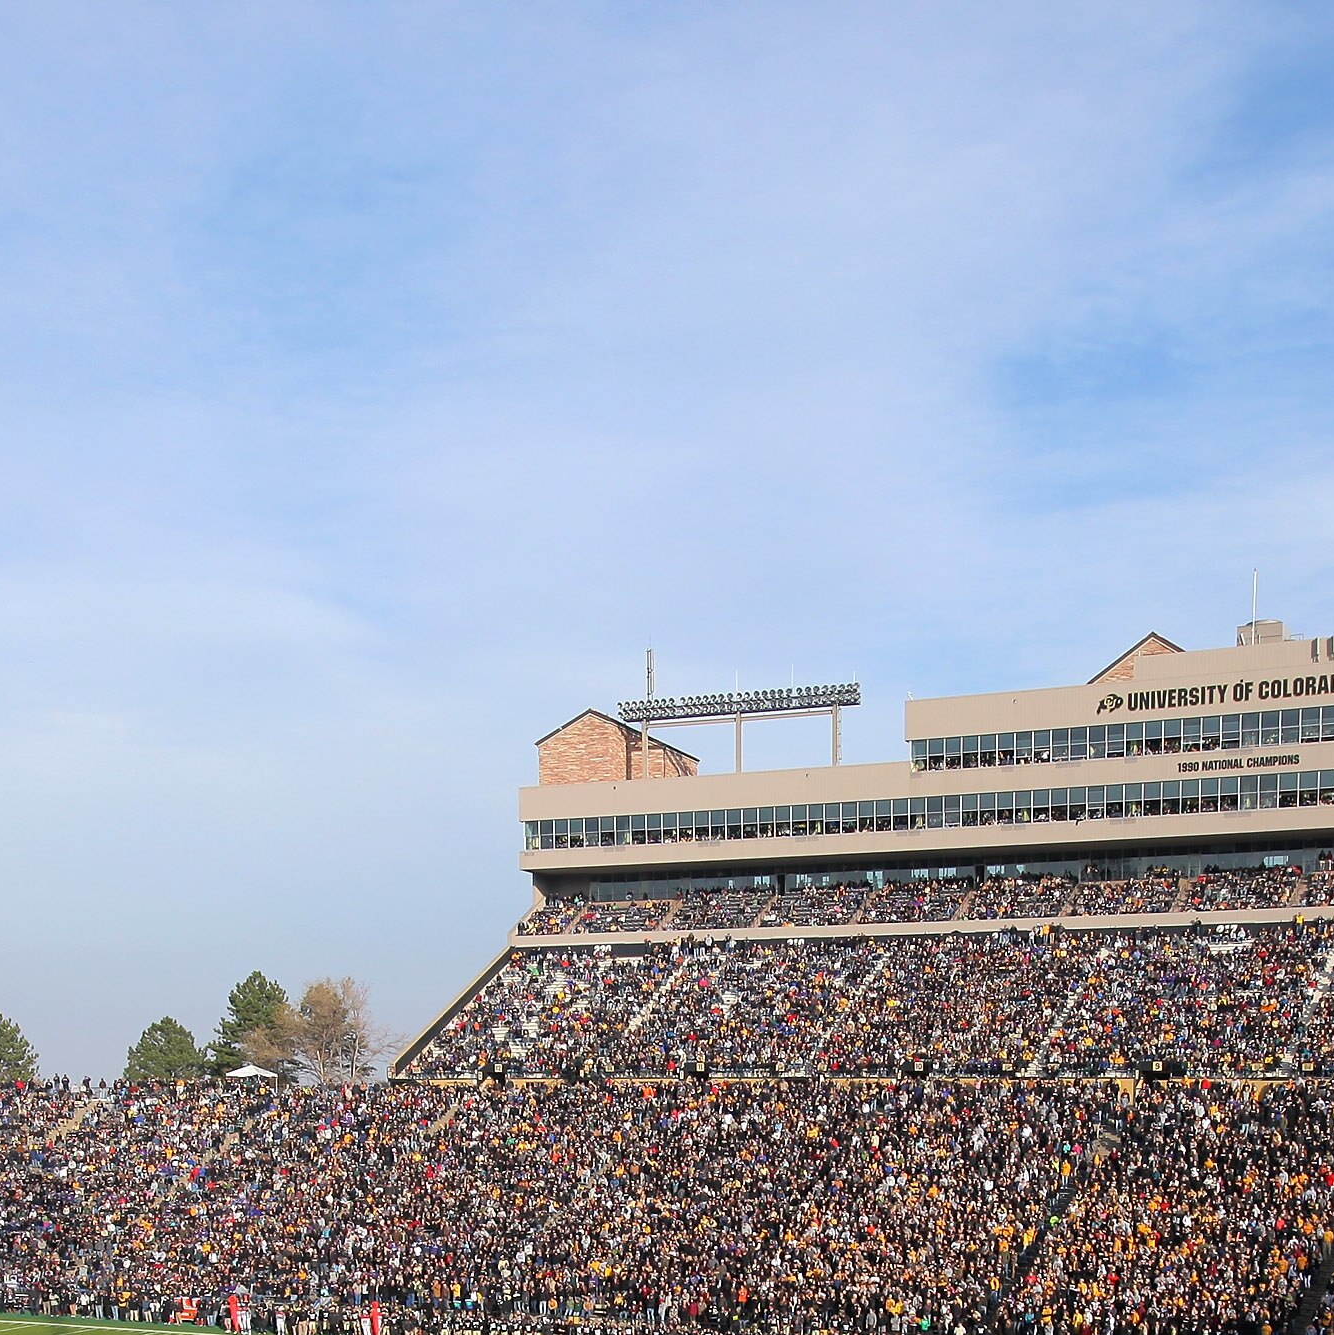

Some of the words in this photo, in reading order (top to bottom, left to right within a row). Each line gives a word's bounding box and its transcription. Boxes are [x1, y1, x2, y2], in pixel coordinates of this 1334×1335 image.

[1127, 684, 1228, 711] UNIVERSITY
[1233, 681, 1253, 701] OF
[1177, 761, 1199, 772] 1990
[1202, 757, 1244, 770] NATIONAL
[1247, 754, 1300, 768] CHAMPIONS
